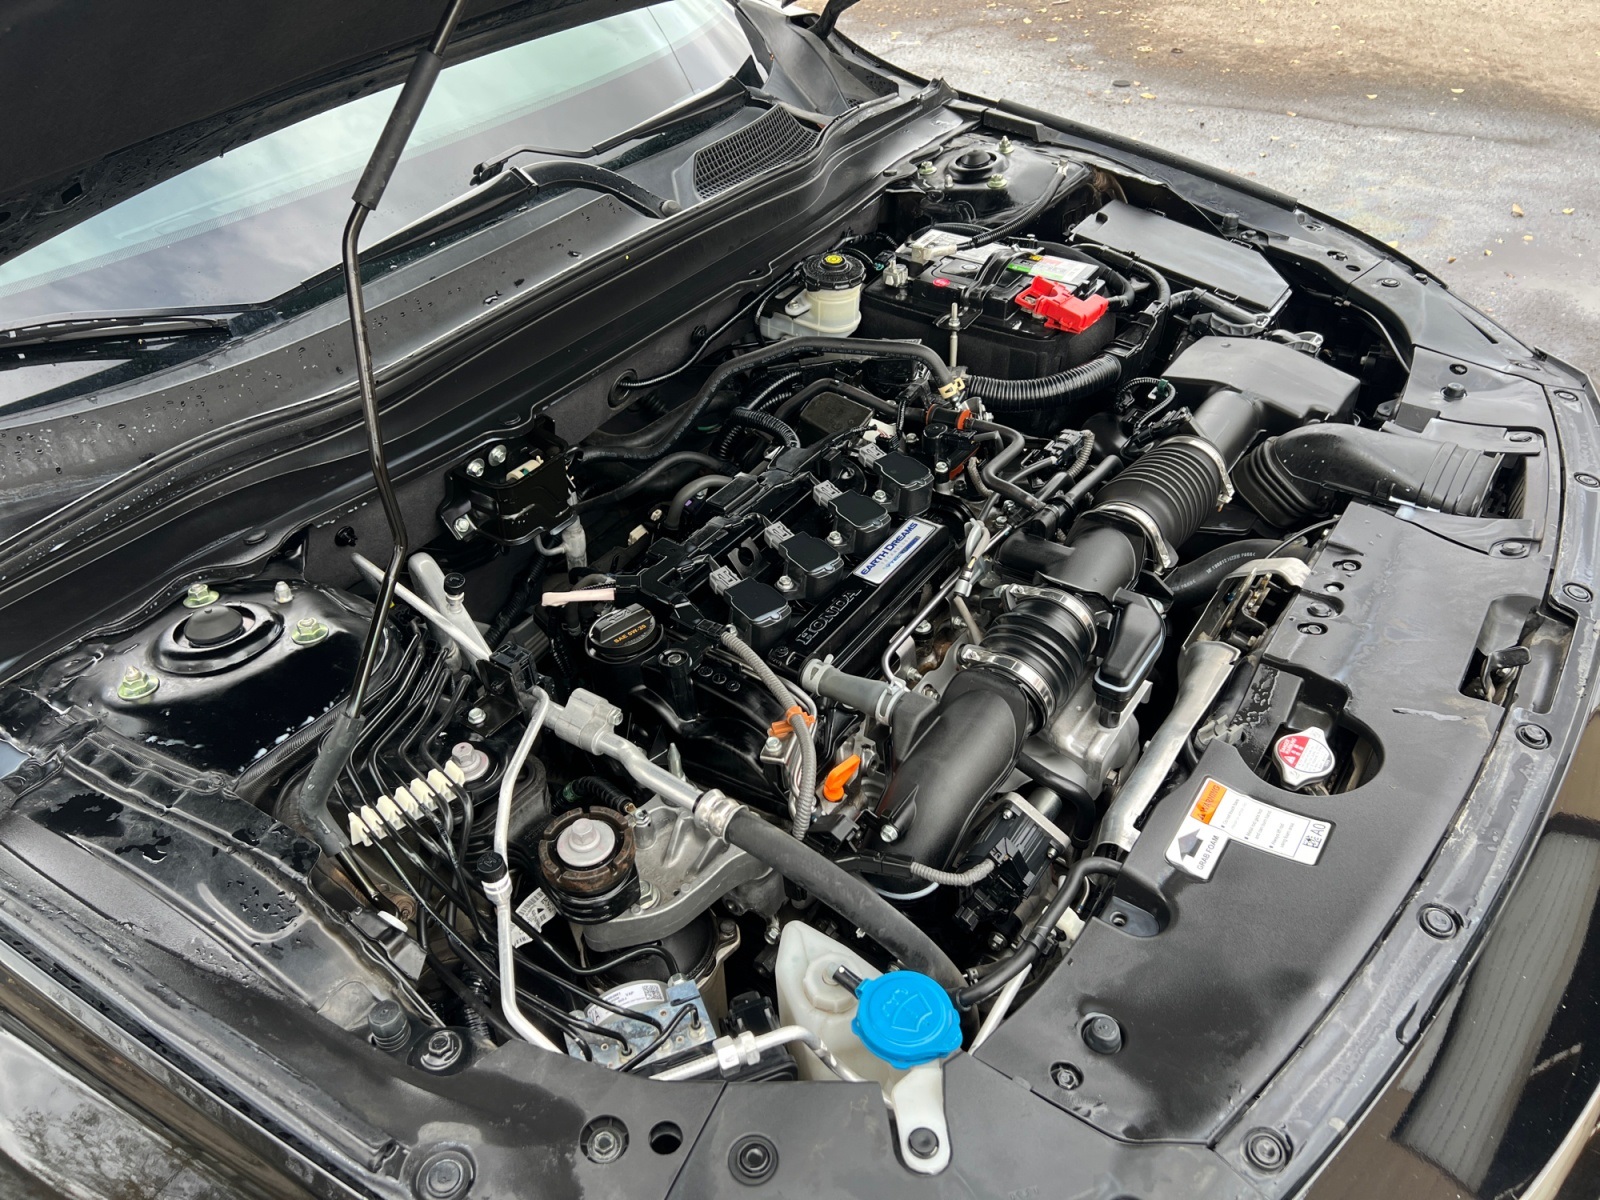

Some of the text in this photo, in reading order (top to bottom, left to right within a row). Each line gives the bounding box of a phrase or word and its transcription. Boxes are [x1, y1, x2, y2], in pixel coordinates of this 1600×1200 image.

[860, 550, 889, 575] EARTH
[885, 522, 918, 551] DREAMS
[795, 589, 862, 645] HONDA
[613, 633, 628, 643] SAE
[1200, 784, 1220, 813] WARNING
[1314, 822, 1327, 838] A0
[1197, 835, 1220, 871] GRAB FOAM
